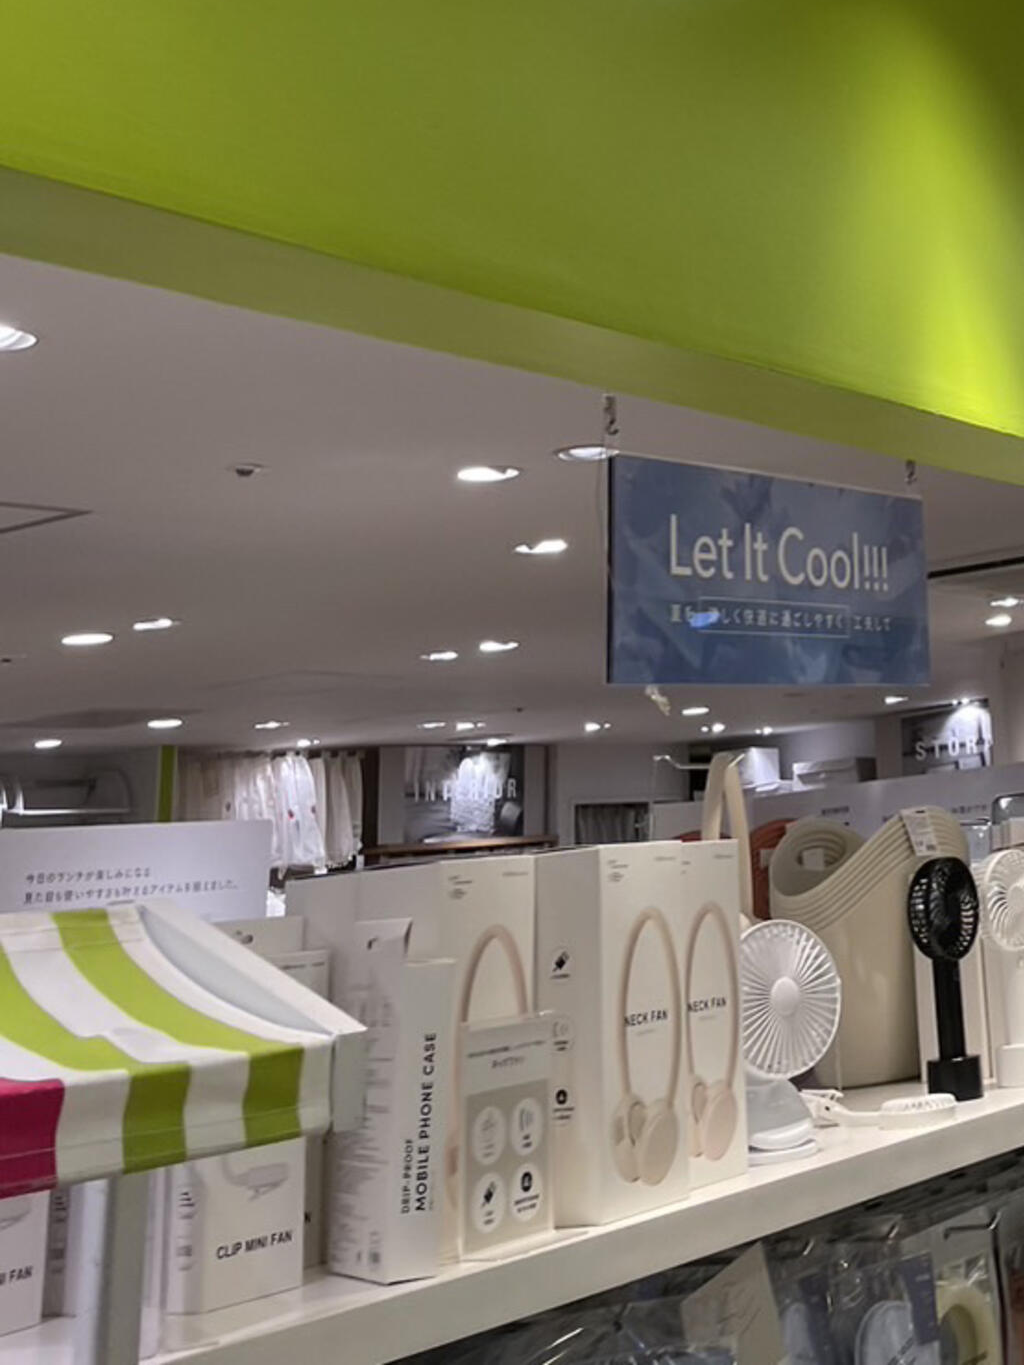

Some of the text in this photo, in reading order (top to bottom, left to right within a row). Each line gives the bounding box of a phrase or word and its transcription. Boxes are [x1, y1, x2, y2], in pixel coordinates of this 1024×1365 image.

[669, 513, 889, 592] Let It Cool!!!
[413, 777, 518, 803] INTRIOR
[624, 1009, 668, 1028] NECK FAN
[687, 996, 727, 1014] NECK FAN
[415, 1033, 437, 1212] MOBILE PHONE CASE
[401, 1139, 414, 1214] DRIP-PROOF
[216, 1229, 294, 1260] CLIP MINI FAN
[8, 1265, 34, 1284] FAN
